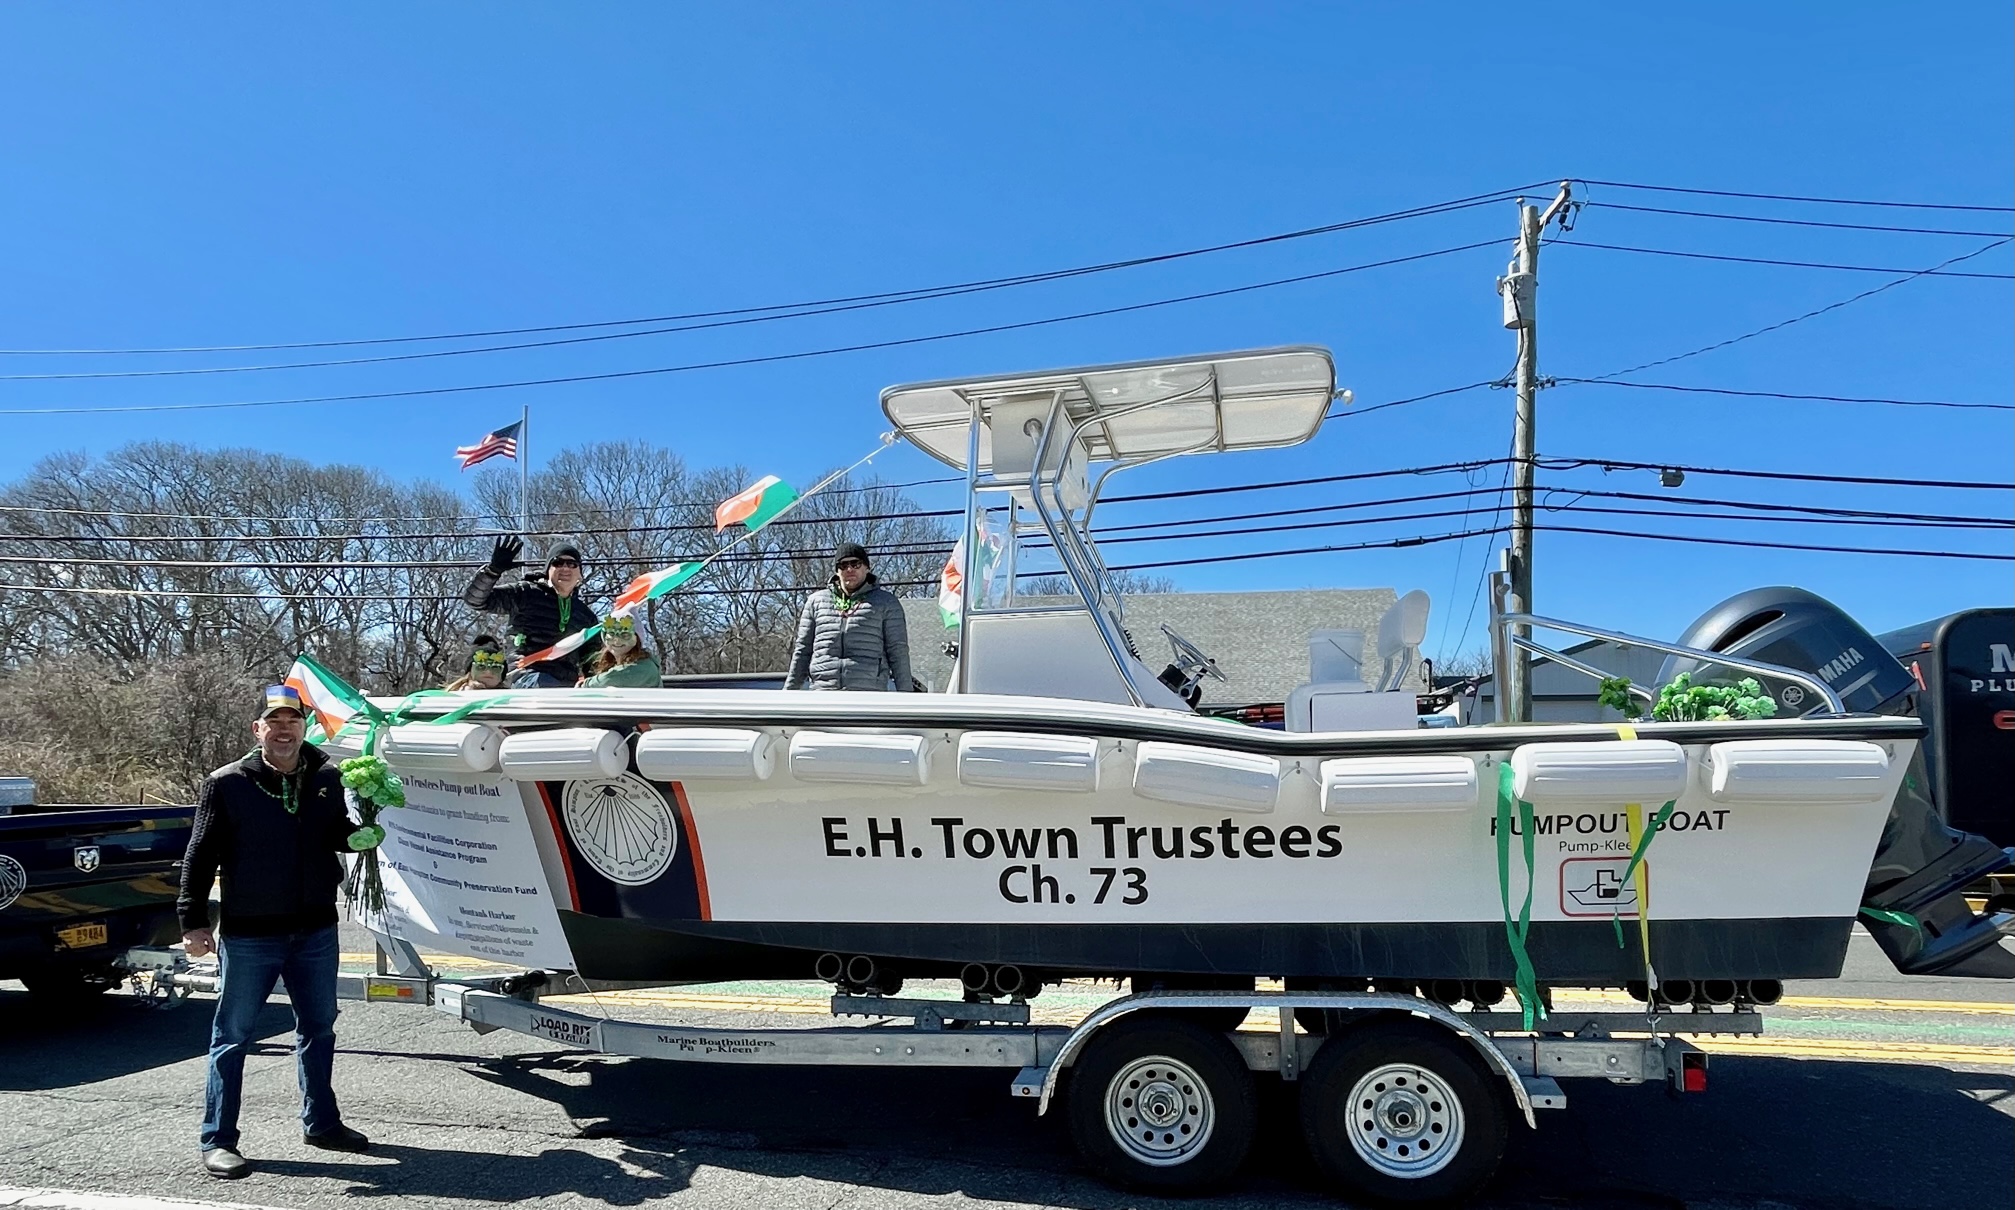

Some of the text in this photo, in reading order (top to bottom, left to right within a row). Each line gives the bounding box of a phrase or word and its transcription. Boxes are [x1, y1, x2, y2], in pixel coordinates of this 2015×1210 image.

[1817, 647, 1865, 684] MAHA
[439, 779, 463, 797] Pump
[464, 784, 478, 796] out
[479, 784, 502, 797] Boat
[1648, 809, 1731, 832] BOAT
[427, 833, 454, 846] Facilities
[455, 838, 498, 851] Corporation
[822, 815, 1344, 860] E.H. Town Trustees
[1559, 839, 1632, 854] Pump-Klee
[425, 845, 457, 860] Assistance
[457, 852, 488, 864] Program
[430, 873, 462, 890] Community
[463, 881, 513, 895] Preservation
[515, 886, 538, 896] Fund
[999, 864, 1150, 906] Ch. 73
[488, 910, 516, 920] Harbor
[541, 1016, 570, 1033] LOAD
[657, 1034, 777, 1048] Marine Boatbuilders
